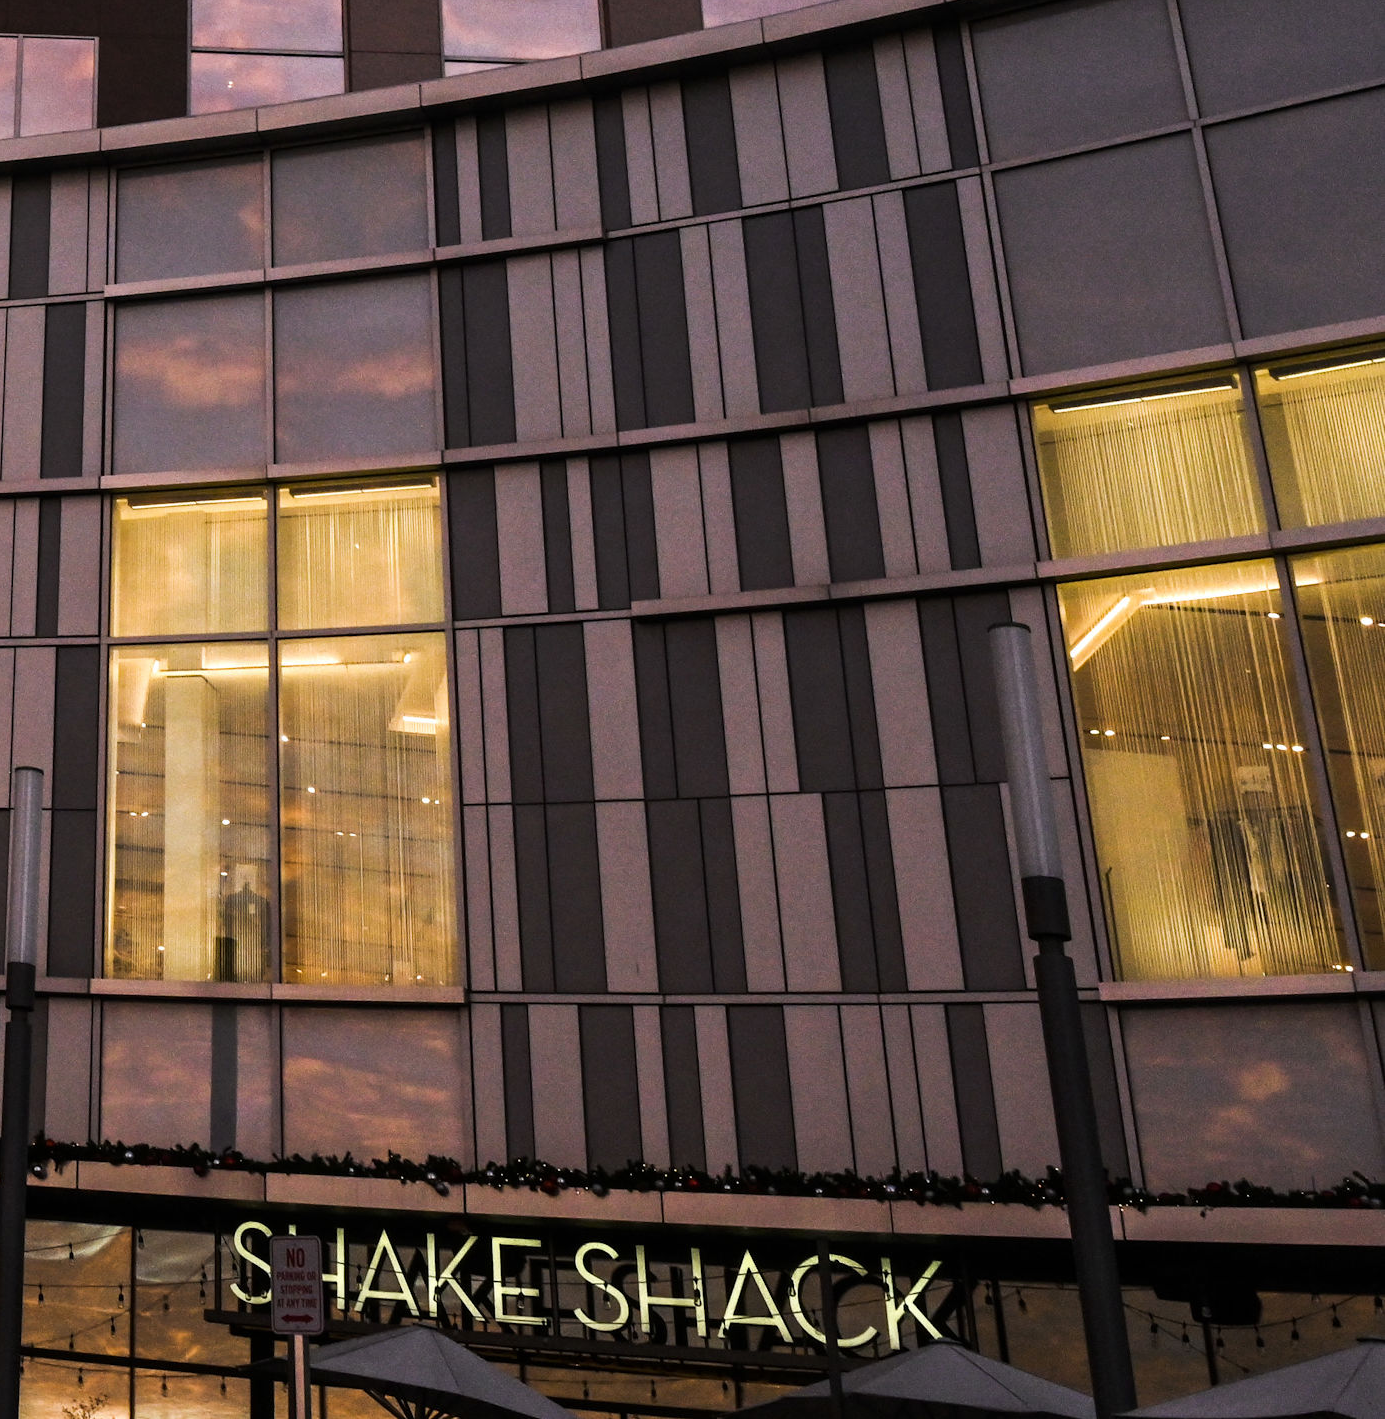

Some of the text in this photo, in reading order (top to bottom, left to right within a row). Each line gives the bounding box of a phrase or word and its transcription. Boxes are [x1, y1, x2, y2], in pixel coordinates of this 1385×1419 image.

[286, 1248, 306, 1268] NO
[276, 1271, 317, 1281] PARKING OR
[229, 1221, 943, 1350] SHAKE SHACK
[280, 1284, 313, 1294] STOPPING
[277, 1299, 318, 1309] AT ANY TIME
